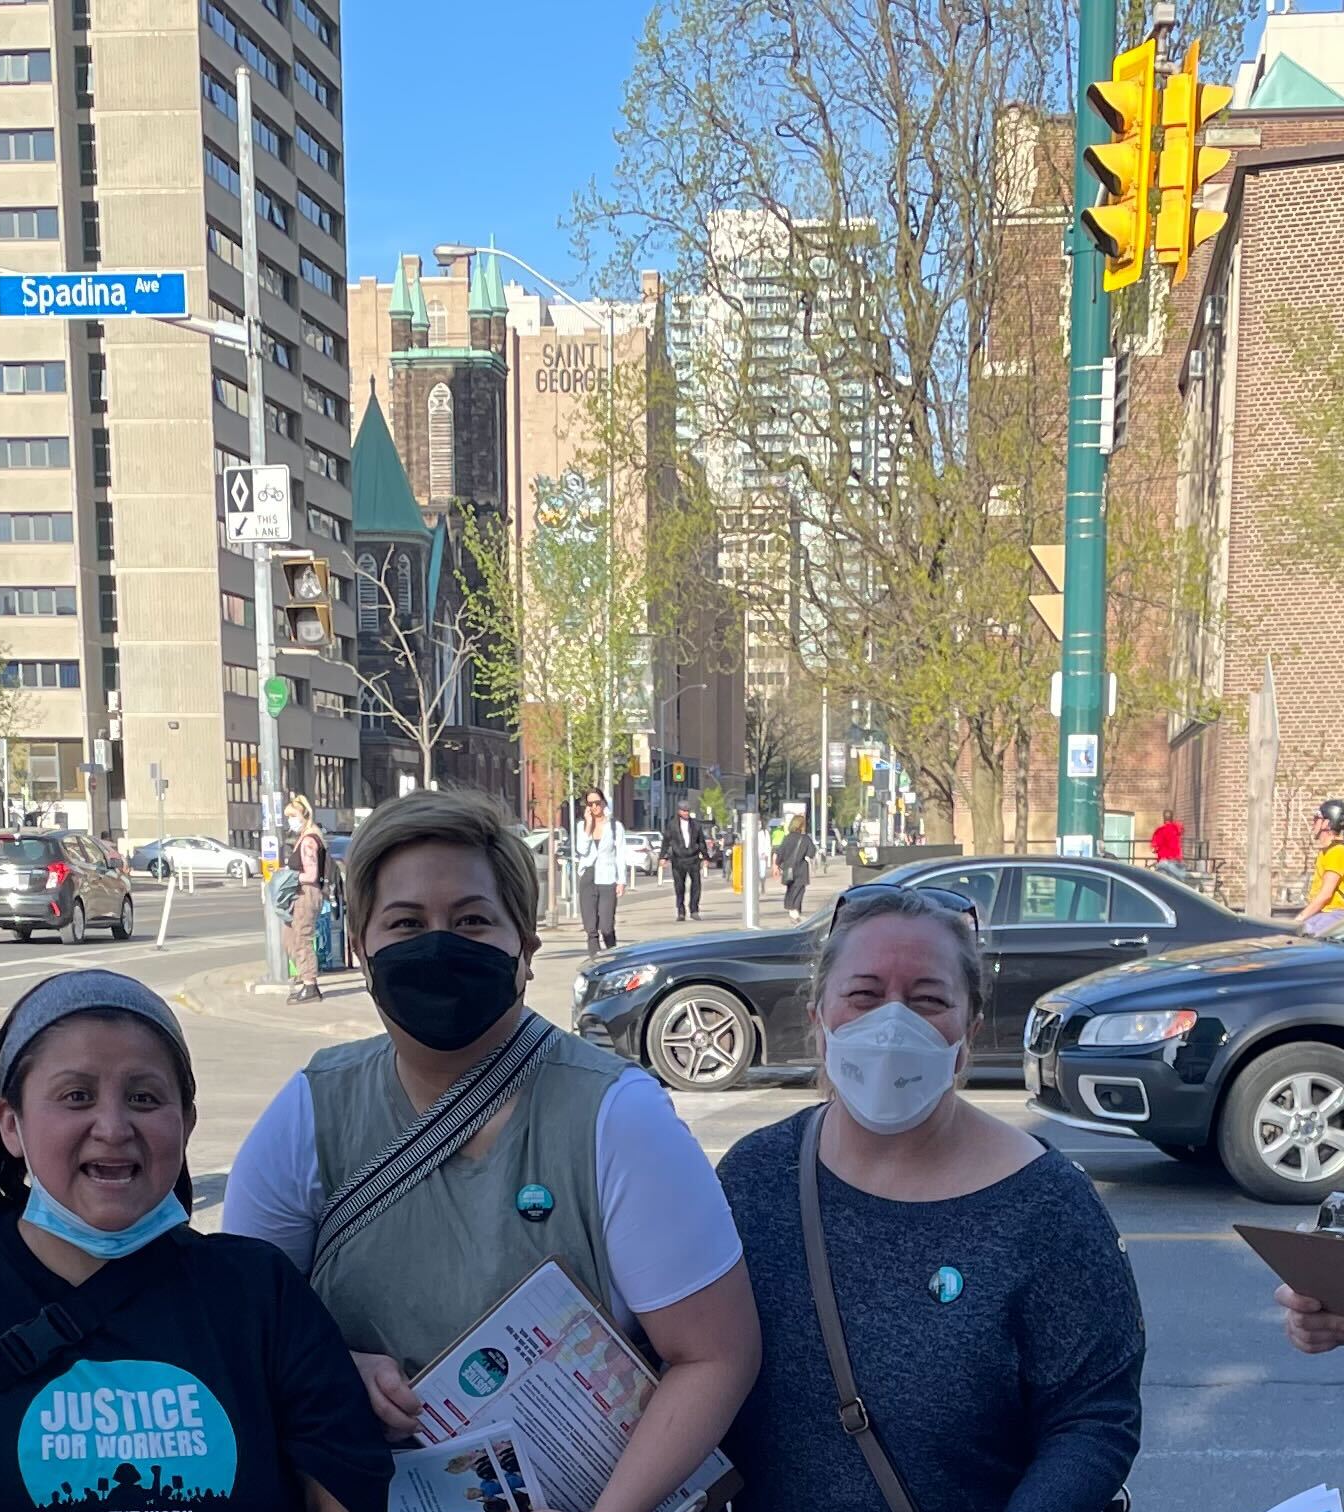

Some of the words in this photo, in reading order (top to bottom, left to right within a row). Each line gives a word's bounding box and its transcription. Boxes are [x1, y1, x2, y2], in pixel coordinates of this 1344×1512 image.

[21, 277, 126, 313] Spadina
[134, 277, 160, 294] Ave
[542, 343, 599, 368] SAINT
[536, 367, 610, 393] GEORGE
[257, 515, 278, 525] THIS
[40, 1384, 204, 1435] JUSTICE
[41, 1433, 87, 1460] FOR
[95, 1430, 208, 1460] WORKERS
